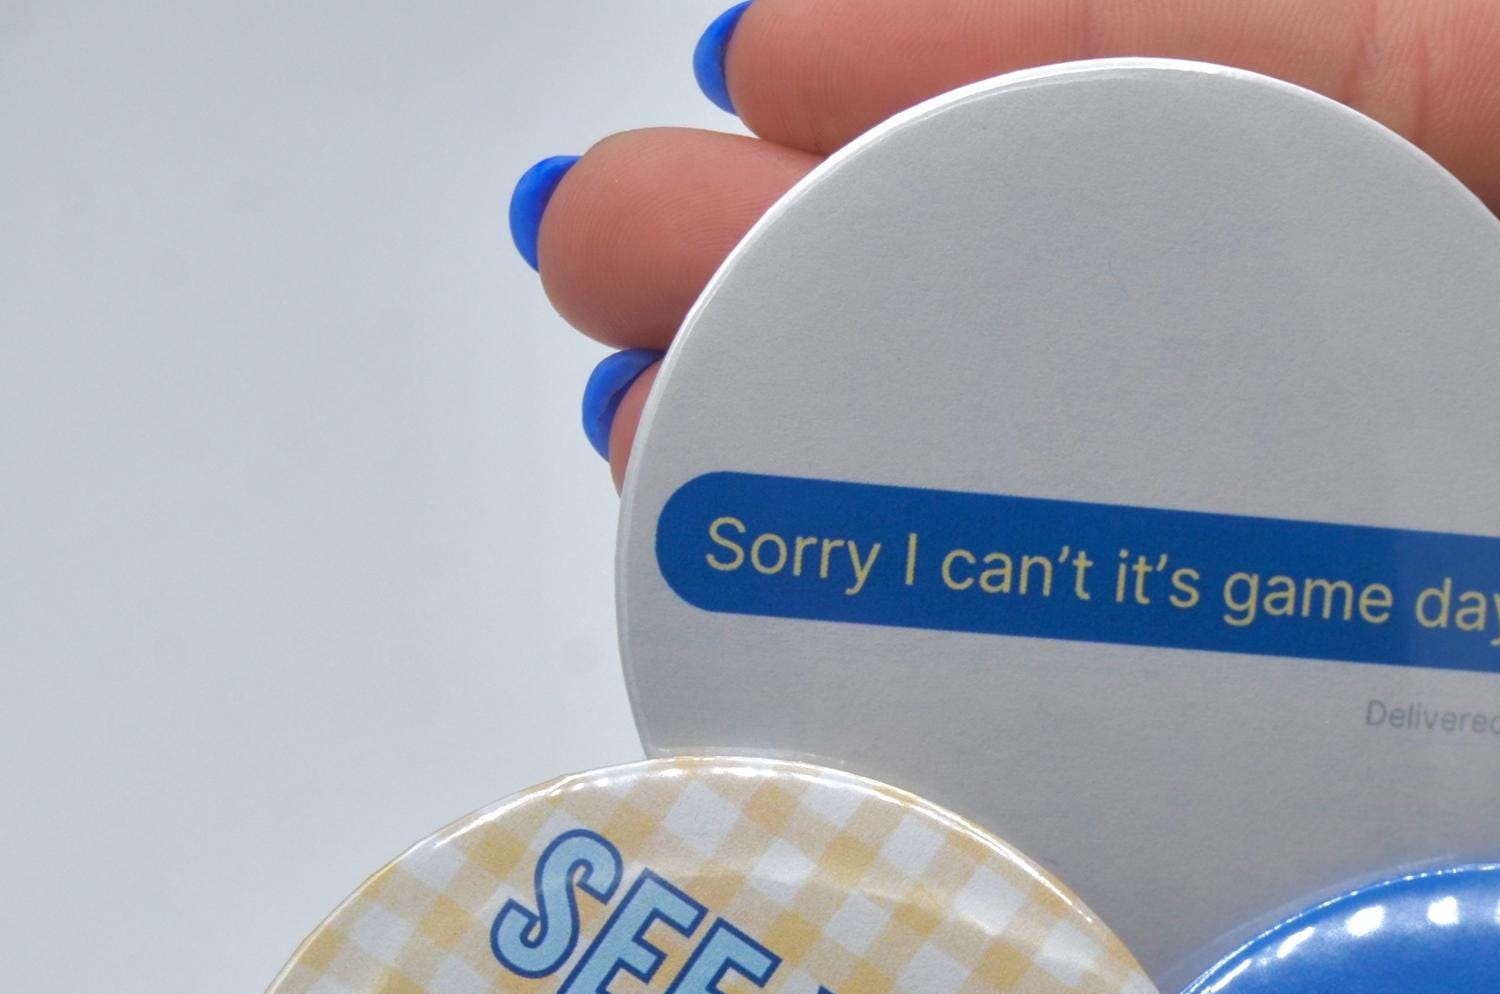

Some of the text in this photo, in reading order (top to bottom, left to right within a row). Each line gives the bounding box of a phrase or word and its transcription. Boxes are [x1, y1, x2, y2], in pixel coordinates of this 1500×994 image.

[705, 516, 881, 594] Sorry
[905, 532, 918, 585] I
[941, 545, 1092, 601] can’t
[1115, 549, 1200, 607] it’s
[1223, 566, 1392, 626] game
